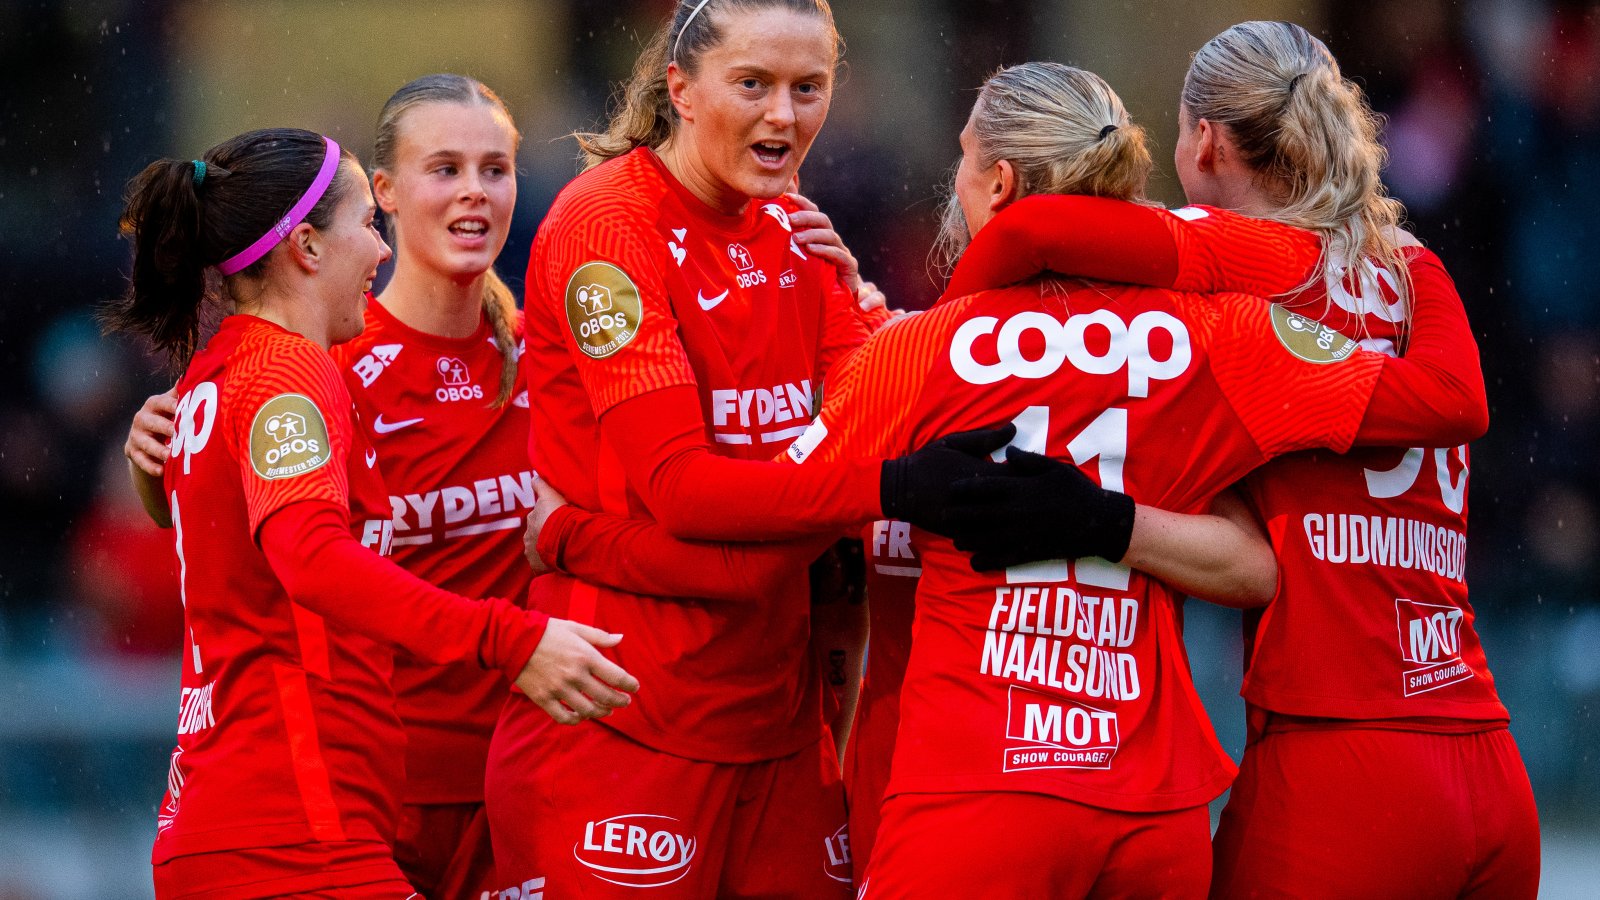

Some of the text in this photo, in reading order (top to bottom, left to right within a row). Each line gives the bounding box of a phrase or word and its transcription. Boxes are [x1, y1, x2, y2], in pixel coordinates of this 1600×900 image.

[736, 269, 767, 288] OBOS
[580, 312, 627, 338] OBOS
[615, 330, 631, 344] 2021
[1316, 325, 1337, 350] OB
[352, 343, 404, 388] BA
[949, 309, 1192, 398] coop
[435, 385, 484, 403] OBOS
[712, 379, 813, 428] FYDEN
[265, 438, 320, 465] OBOS
[388, 470, 536, 531] RYDEN
[988, 586, 1139, 648] FJELDSTAD
[1409, 609, 1463, 662] MOT
[979, 630, 1141, 701] NAALSUND
[1410, 673, 1433, 688] SHOW
[1023, 703, 1117, 746] MOT
[1012, 752, 1049, 765] SHOW
[583, 821, 692, 866] LERØY
